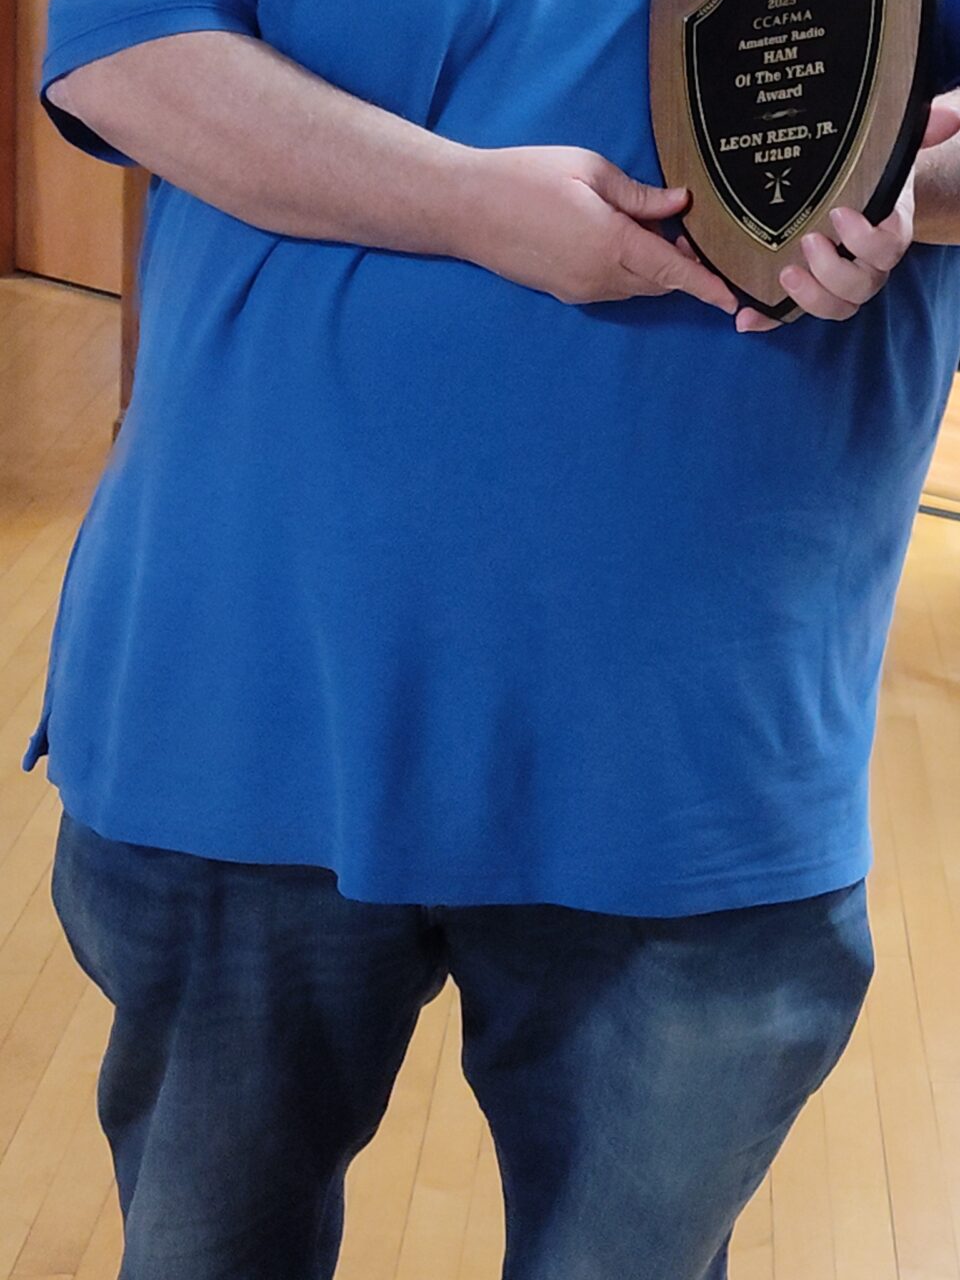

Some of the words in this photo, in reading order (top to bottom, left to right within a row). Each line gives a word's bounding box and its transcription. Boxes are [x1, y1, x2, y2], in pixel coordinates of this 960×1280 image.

[753, 9, 813, 29] CCAFMA
[738, 33, 788, 51] Amateur
[791, 26, 825, 41] Radio
[763, 46, 798, 64] HAM
[755, 70, 781, 84] The
[785, 61, 825, 79] YEAR
[756, 84, 803, 103] Award
[720, 132, 763, 151] LEON
[766, 125, 812, 144] REED,
[815, 121, 838, 139] JR.
[754, 145, 801, 163] KJ2LBR
